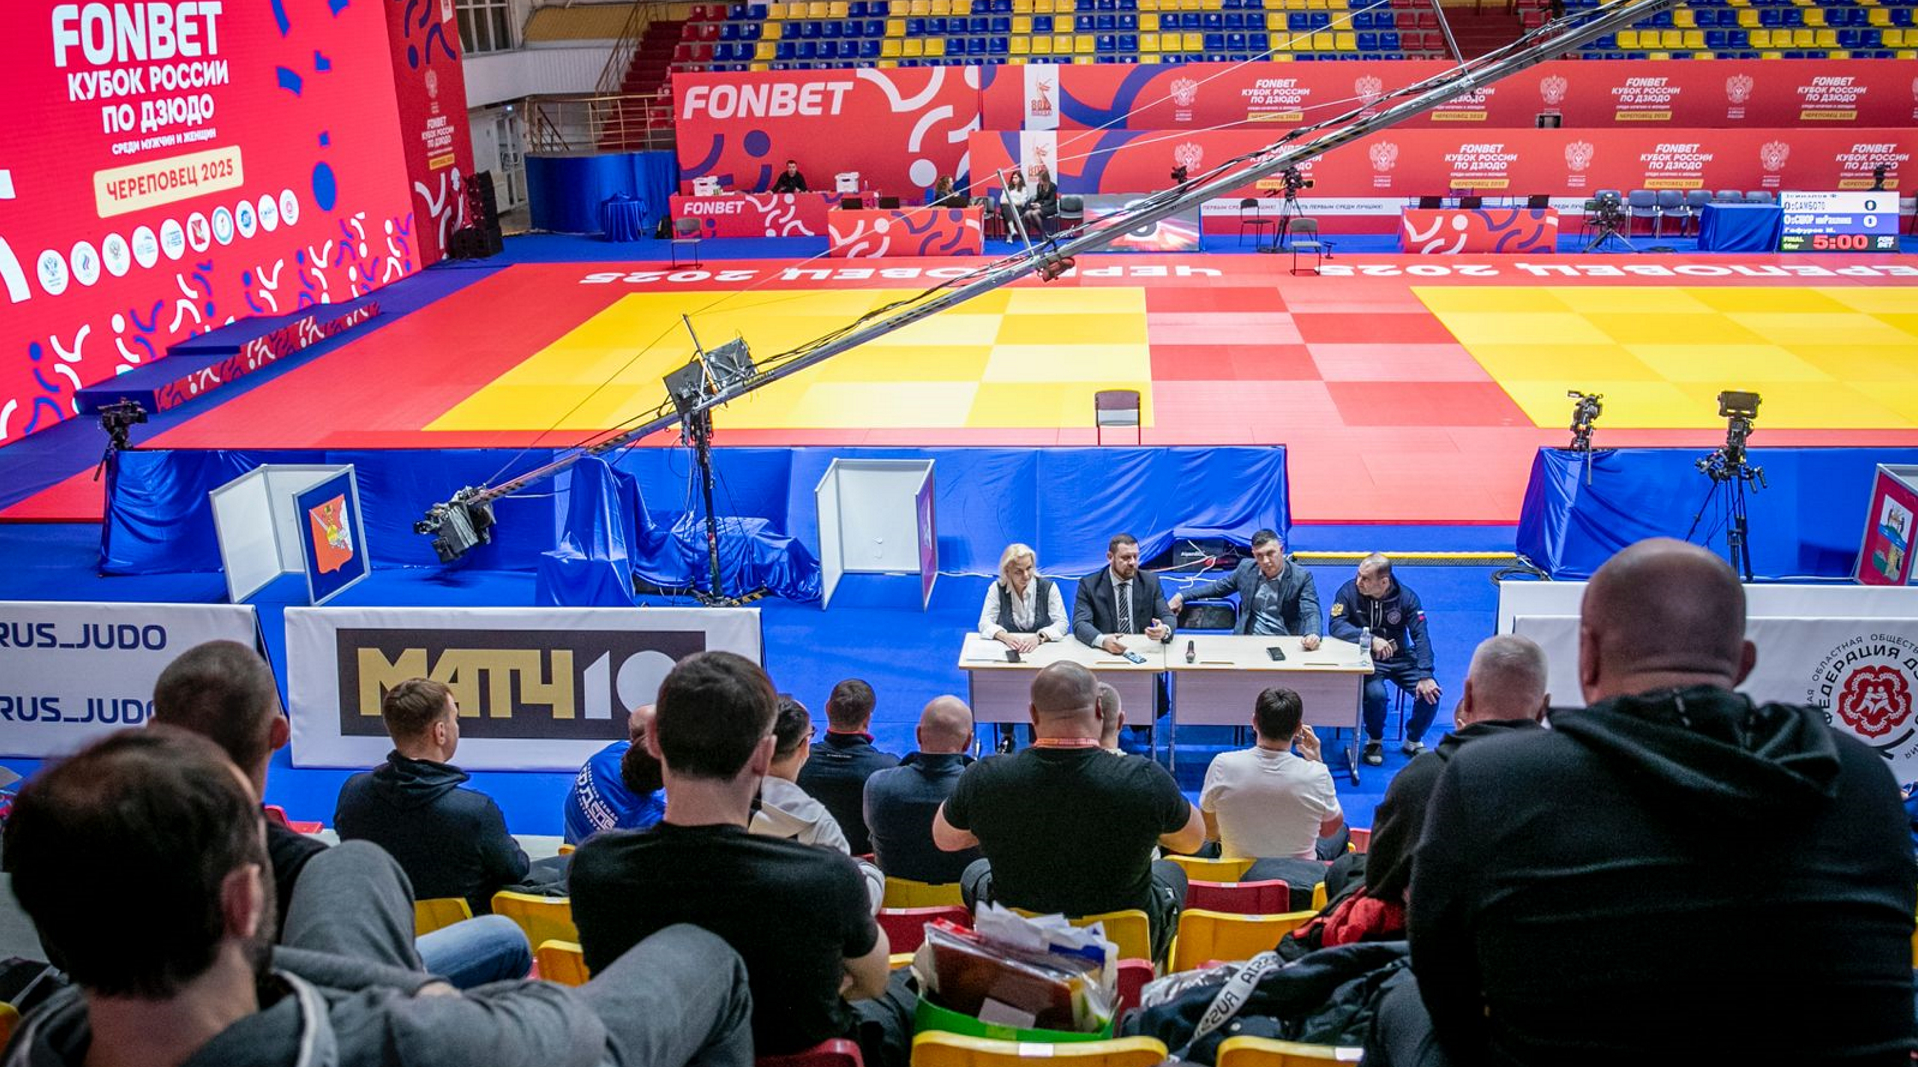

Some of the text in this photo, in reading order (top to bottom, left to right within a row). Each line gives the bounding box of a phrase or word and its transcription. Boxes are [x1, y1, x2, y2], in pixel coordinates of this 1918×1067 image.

[52, 1, 222, 67] FONBET
[68, 60, 229, 101] КУБОК РОССИИ
[1256, 79, 1297, 88] FONBET
[1626, 77, 1668, 87] FONBET
[1812, 76, 1855, 86] FONBET
[1241, 88, 1310, 96] КУБОК РОССИИ
[1611, 87, 1642, 95] КУБОК
[1829, 86, 1867, 94] РОССИИ
[682, 81, 854, 119] FONBET
[1266, 96, 1301, 104] ДЗЮДО
[1635, 95, 1671, 103] ДЗЮДО
[1820, 94, 1857, 102] ДЗЮДО
[102, 94, 215, 133] ПО ДЗЮДО
[112, 128, 217, 155] СРЕДИ МУЖЧИН И ЖЕНЩИН
[1460, 144, 1504, 153] FONBET
[1655, 143, 1700, 153] FONBET
[1852, 143, 1896, 153] FONBET
[1445, 153, 1517, 162] КУБОК РОССИИ
[1640, 153, 1713, 161] КУБОК РОССИИ
[1836, 153, 1909, 161] КУБОК РОССИИ
[1470, 162, 1507, 170] ДЗЮДО
[1665, 162, 1702, 170] ДЗЮДО
[106, 159, 234, 200] ЧЕРЕПОВЕЦ 2025
[683, 200, 745, 215] FONBET
[1864, 200, 1877, 211] 0
[1863, 215, 1877, 228] 0
[1813, 234, 1868, 249] 5:00
[578, 265, 1222, 285] ЧЕРОВЕЦ 2025
[1314, 264, 1499, 276] 2025
[0, 623, 167, 650] US_JUDO
[1812, 635, 1863, 682] ОБЛАСТНАЯ
[0, 696, 154, 724] RUS_JUD
